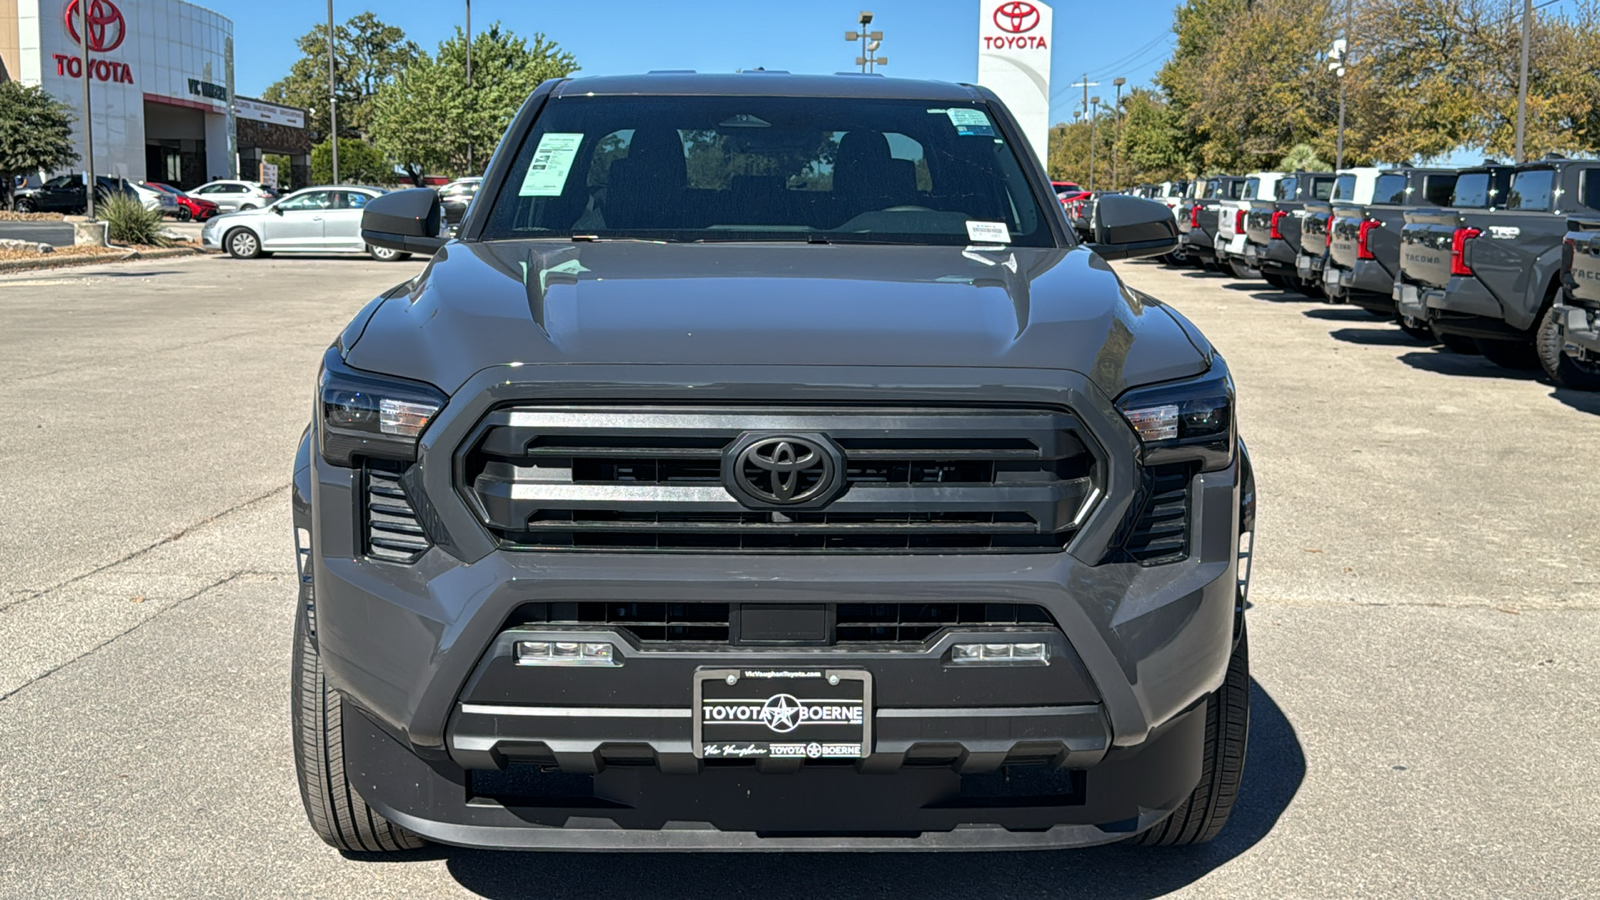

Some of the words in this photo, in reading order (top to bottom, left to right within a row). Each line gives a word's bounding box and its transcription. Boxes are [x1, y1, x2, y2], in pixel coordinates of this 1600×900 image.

[983, 36, 1047, 50] TOYOTA
[52, 53, 134, 84] TOYOTA
[1488, 225, 1521, 236] TRD
[1405, 253, 1440, 264] TACOMA
[744, 670, 821, 679] VicVaughanToyota.com
[703, 706, 772, 720] TOYOTA
[799, 706, 863, 720] BOERNE
[769, 746, 806, 754] TOYOTA
[822, 746, 861, 754] BOERNE
